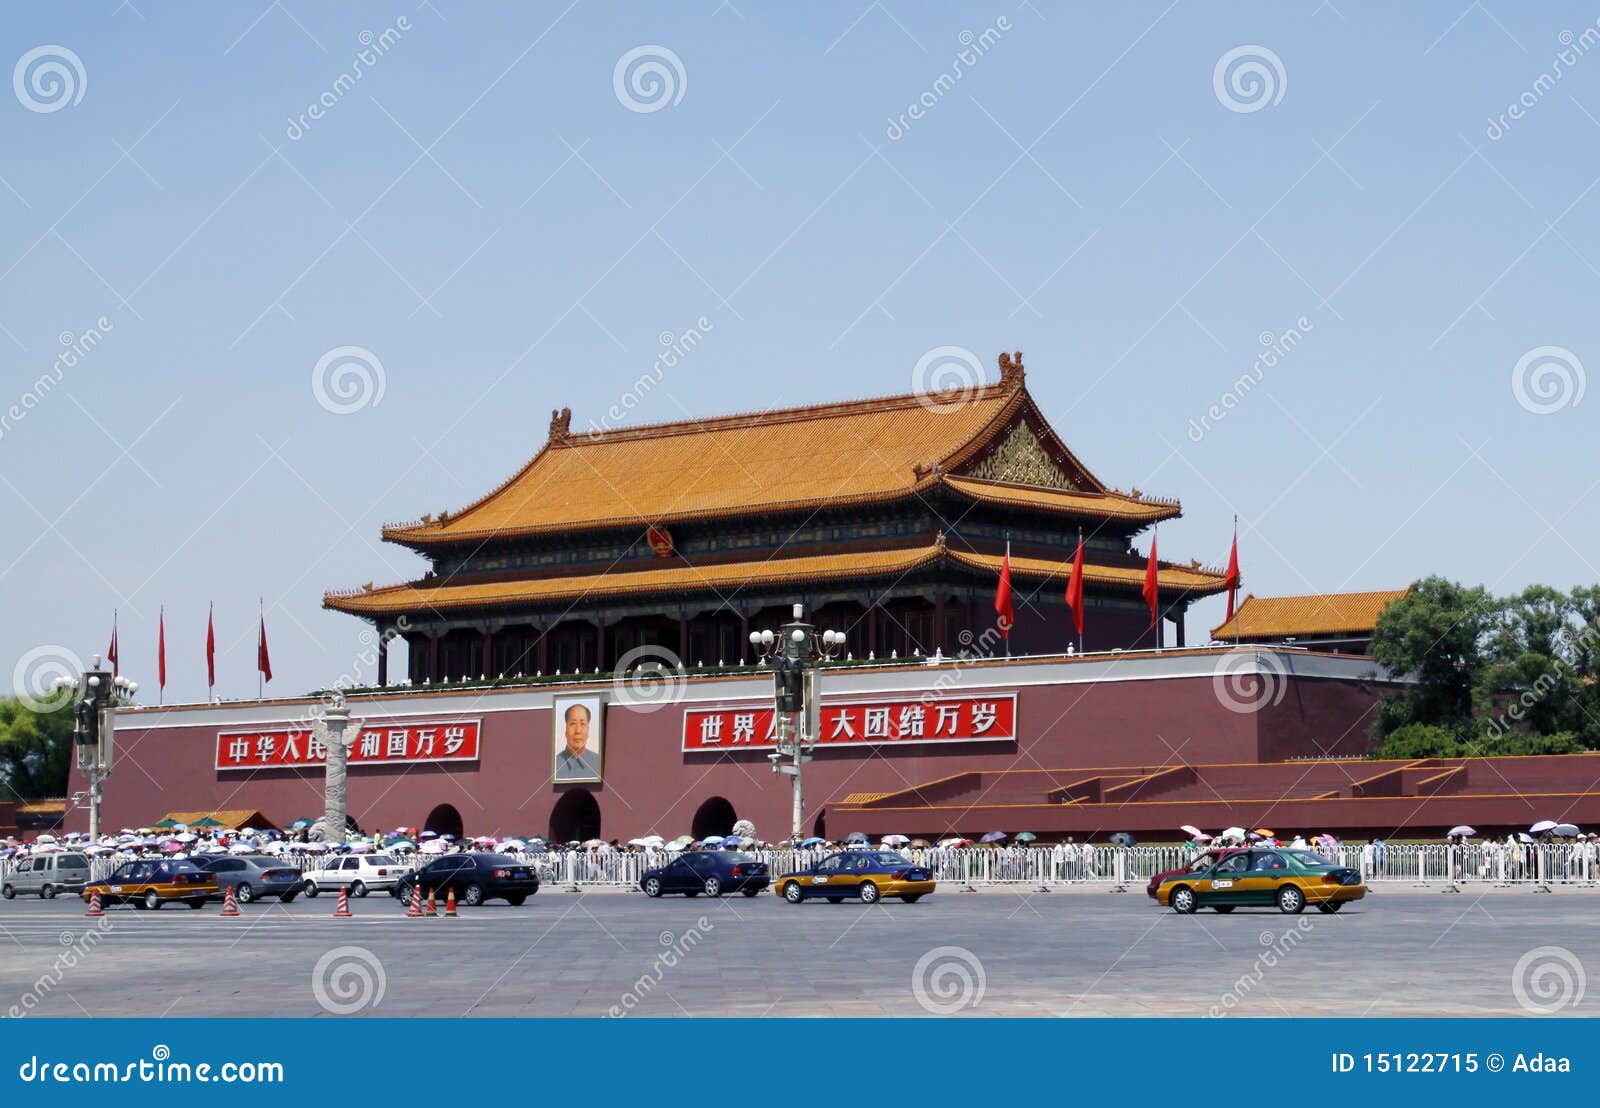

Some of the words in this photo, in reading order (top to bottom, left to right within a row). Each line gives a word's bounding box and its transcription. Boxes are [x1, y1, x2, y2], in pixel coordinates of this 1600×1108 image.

[699, 702, 998, 745] 世界大团结万岁
[228, 727, 466, 763] 中华人民和国万岁
